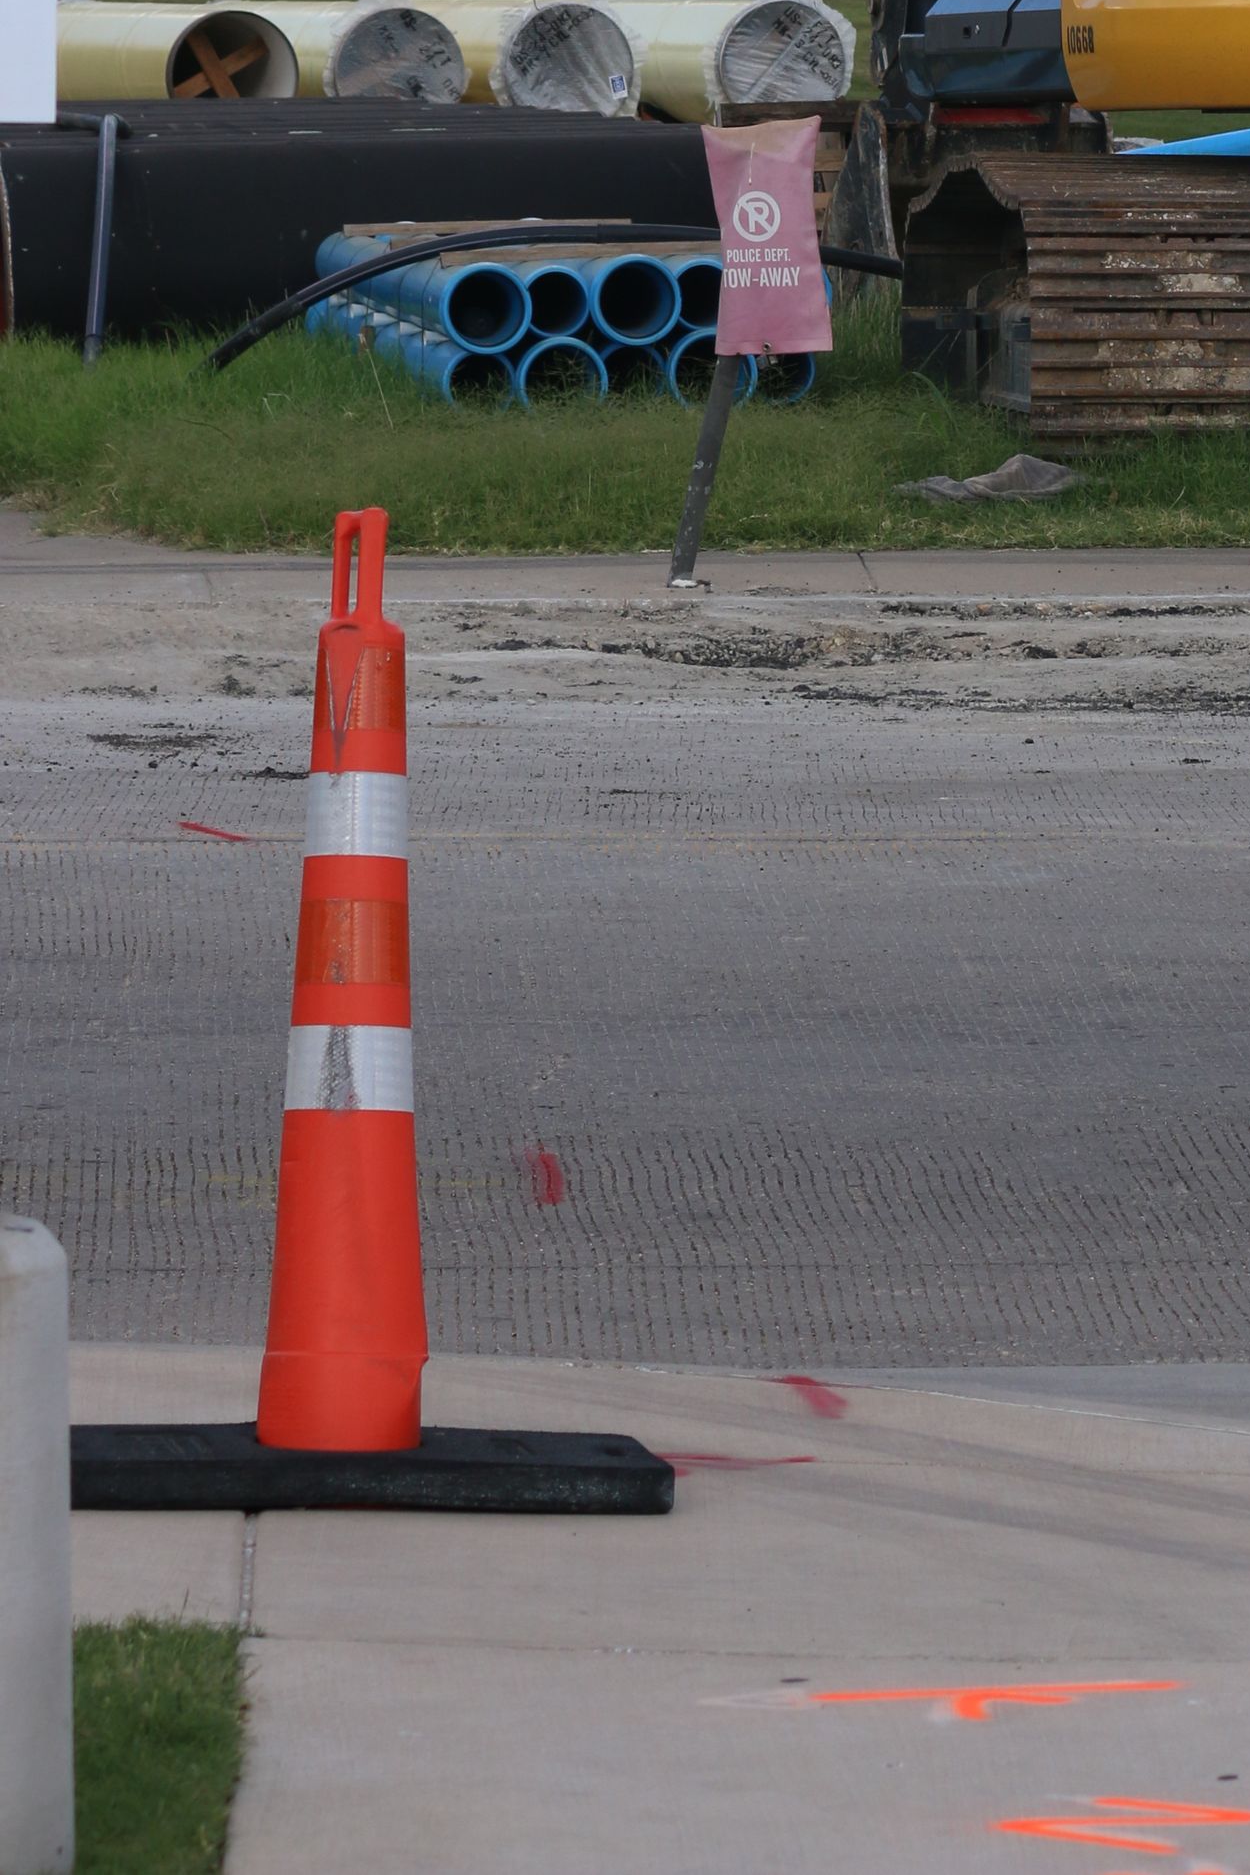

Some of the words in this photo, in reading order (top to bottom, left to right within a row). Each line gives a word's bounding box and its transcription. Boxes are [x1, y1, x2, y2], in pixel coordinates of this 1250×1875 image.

[1066, 25, 1095, 54] 10668
[726, 248, 761, 263] POLICE
[764, 247, 791, 262] DEPT.
